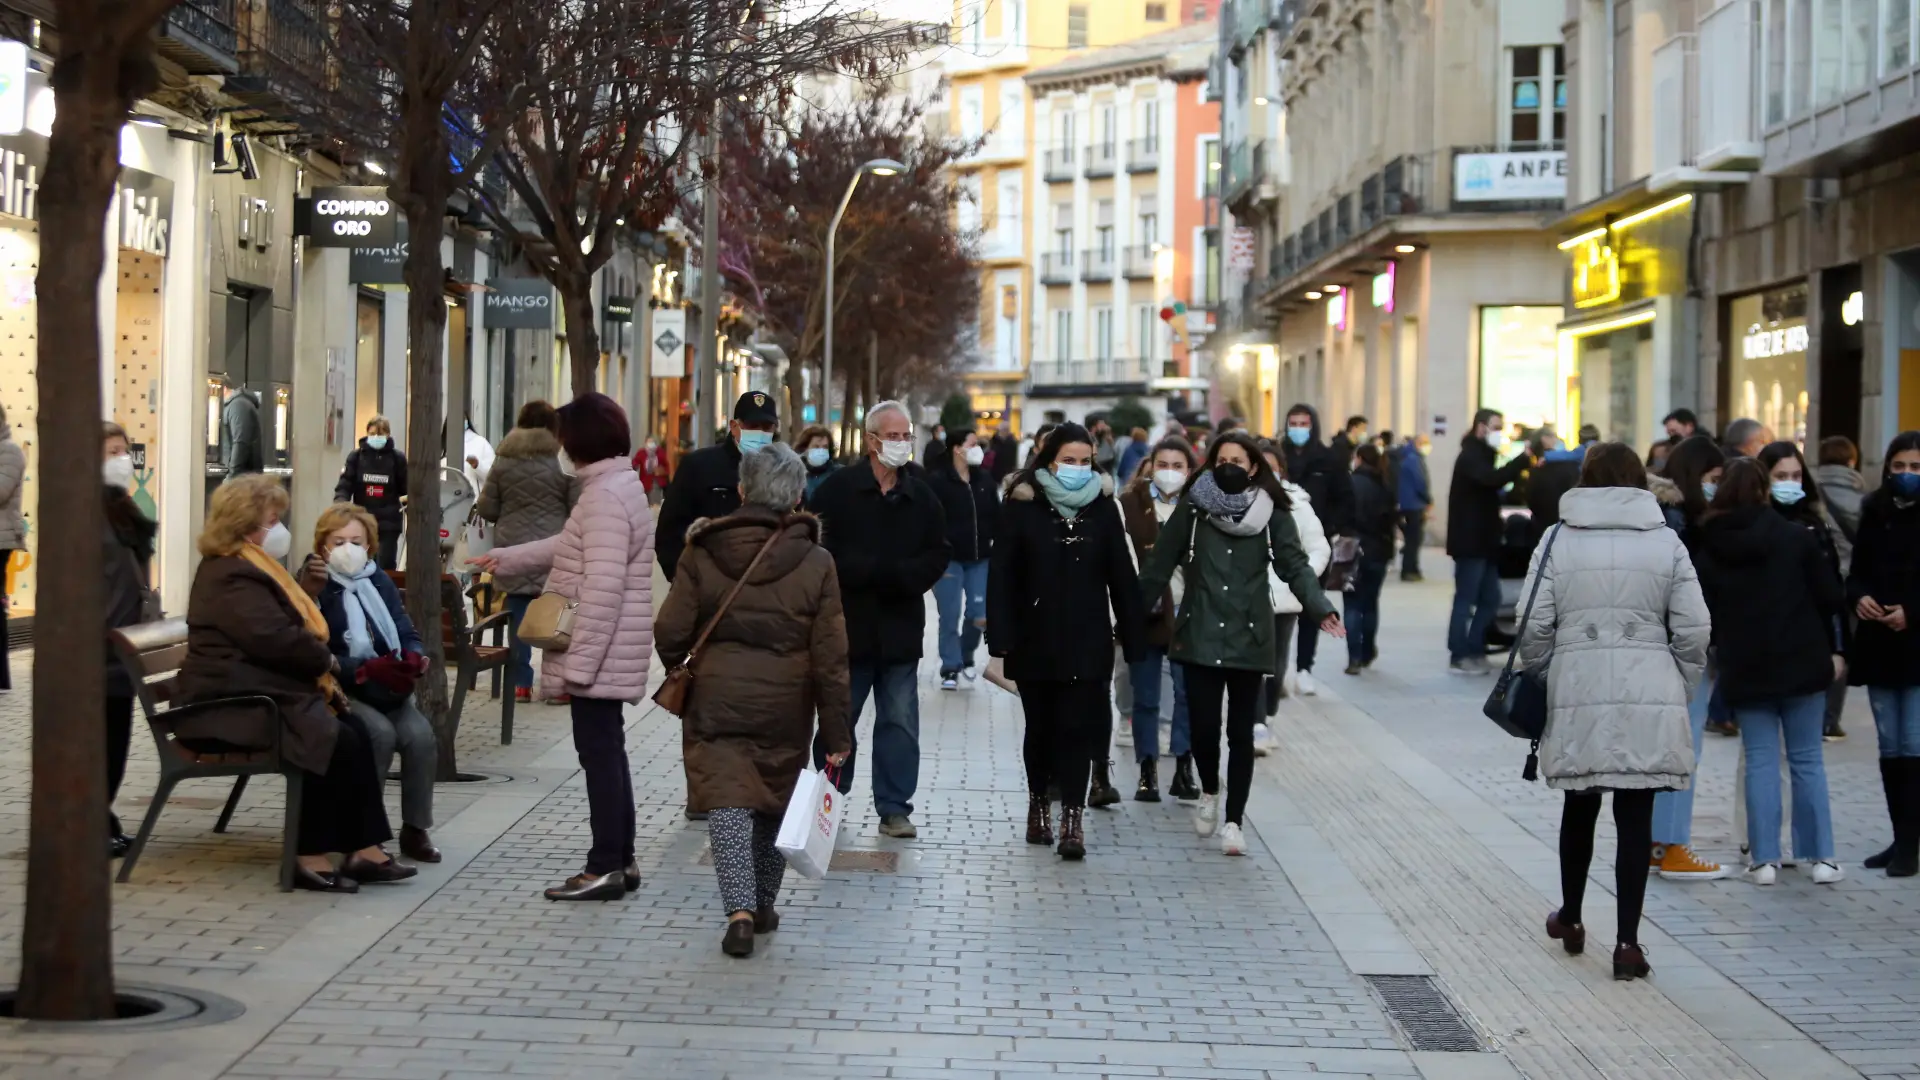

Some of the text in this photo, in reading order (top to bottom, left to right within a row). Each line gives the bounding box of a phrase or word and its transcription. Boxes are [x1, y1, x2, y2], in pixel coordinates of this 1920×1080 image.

[317, 199, 390, 216] COMPRO
[333, 220, 372, 236] ORO
[488, 295, 549, 308] MANGO
